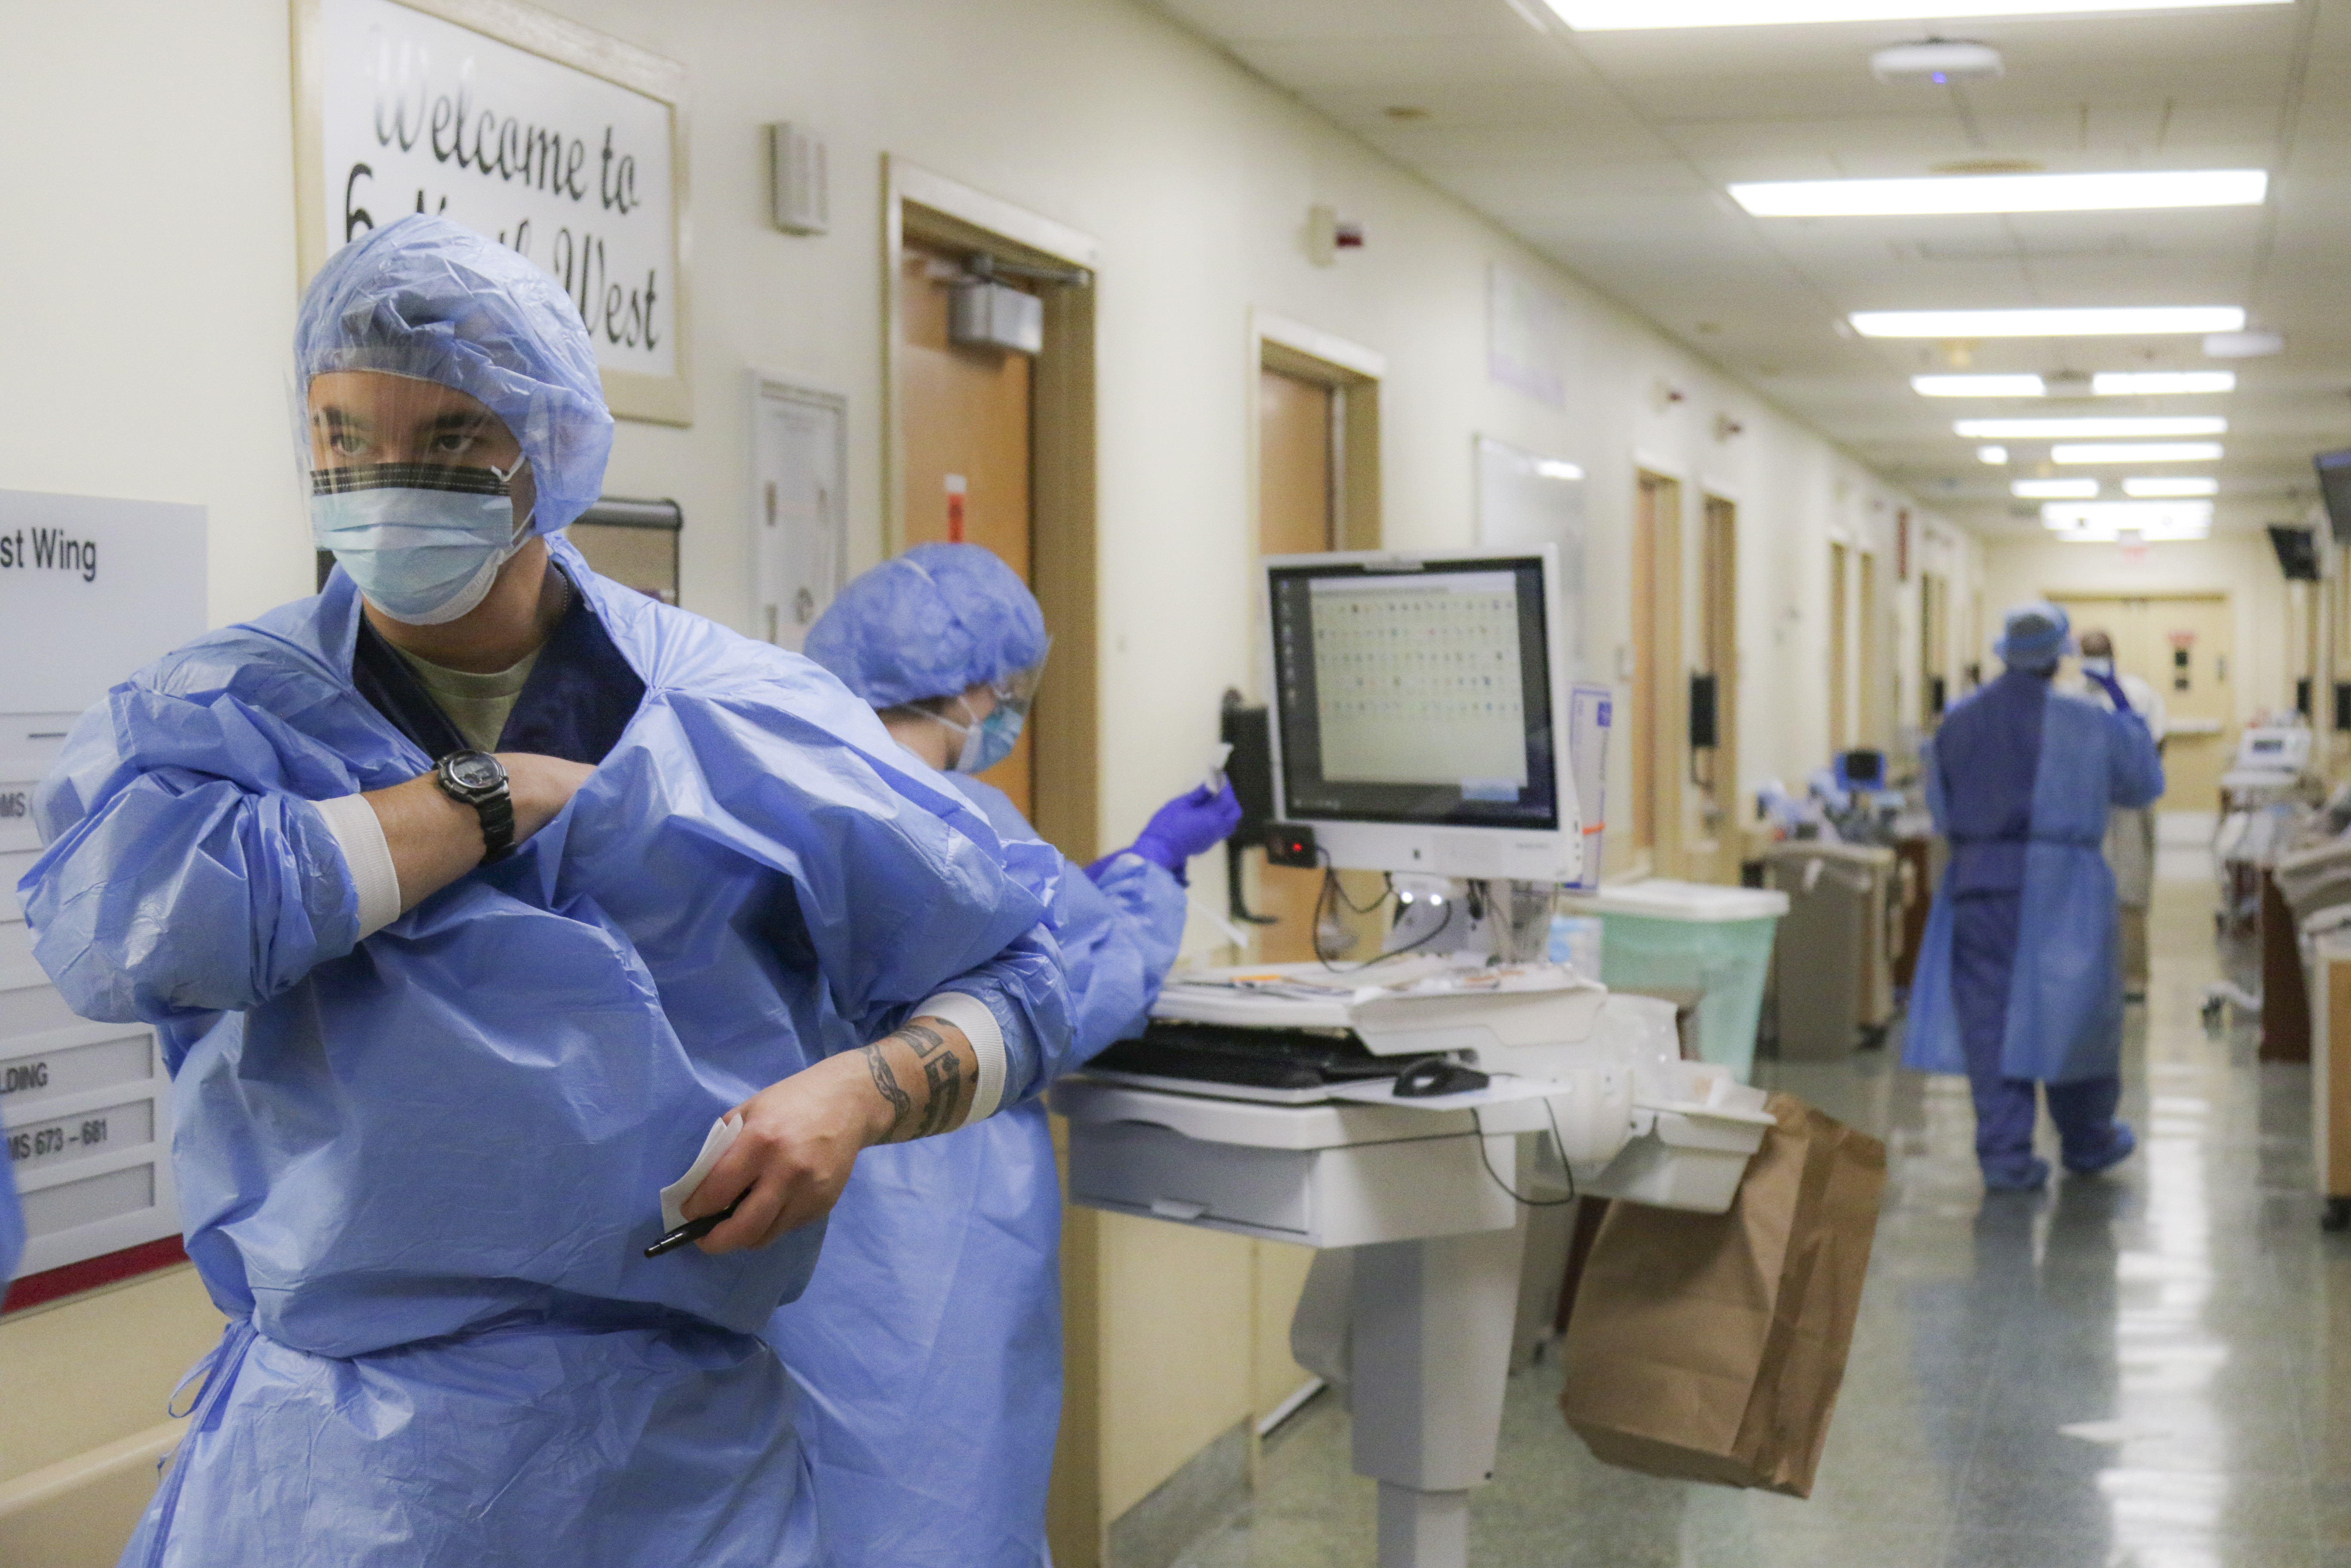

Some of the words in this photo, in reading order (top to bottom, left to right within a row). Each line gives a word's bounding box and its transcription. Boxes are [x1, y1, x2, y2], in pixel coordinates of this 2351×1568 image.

[365, 25, 588, 201] Welcome
[602, 125, 640, 214] to
[555, 227, 660, 351] West
[31, 527, 96, 582] Wing
